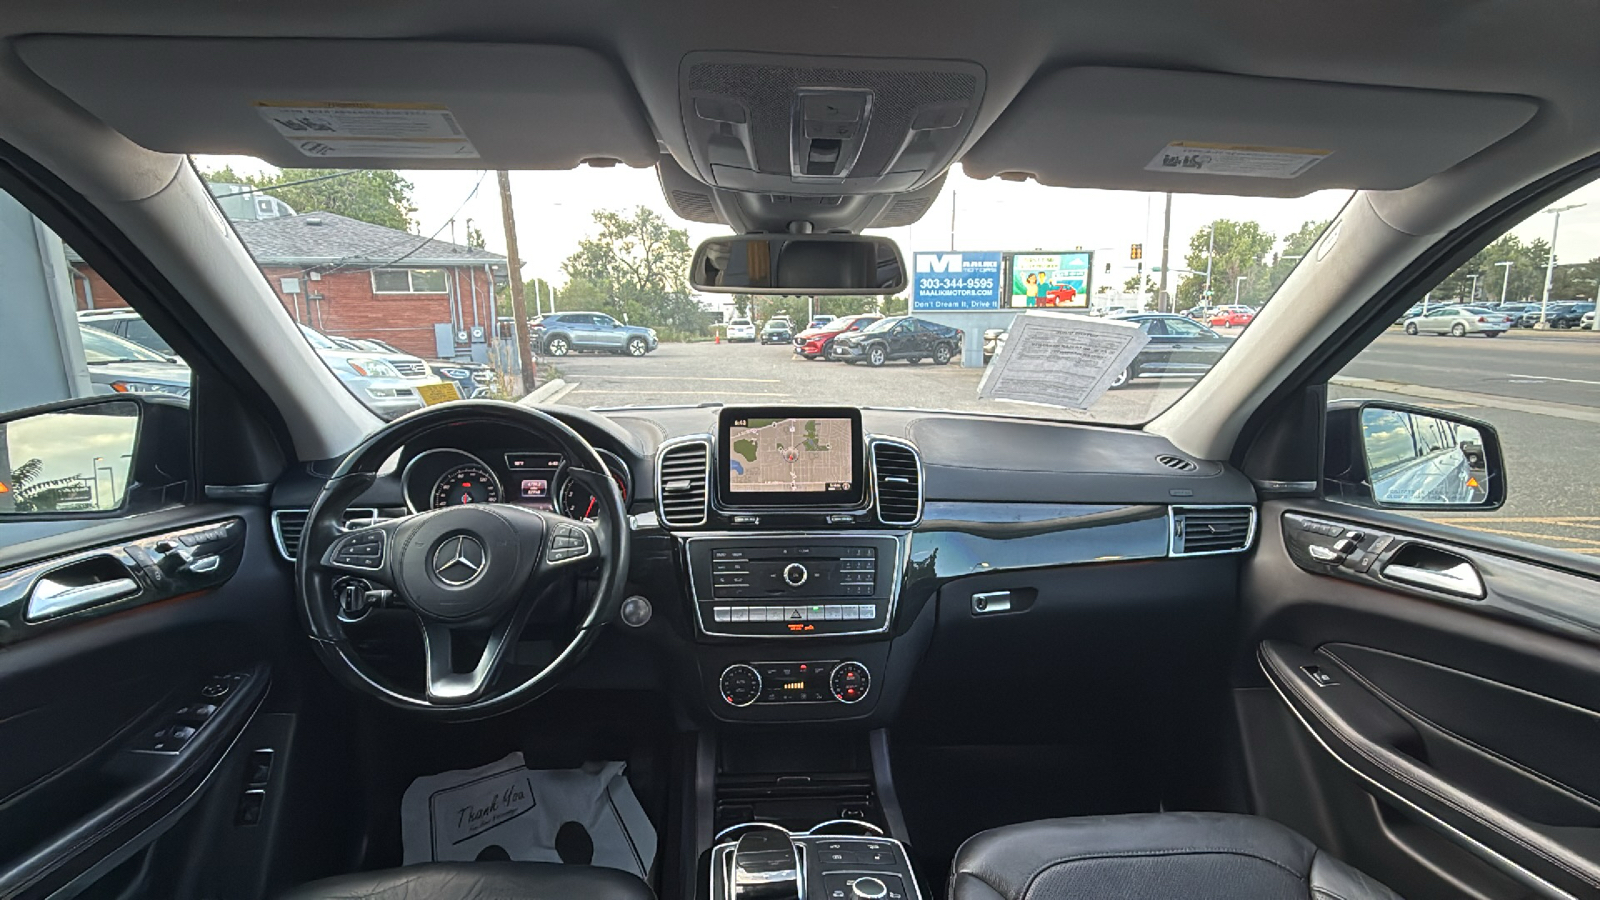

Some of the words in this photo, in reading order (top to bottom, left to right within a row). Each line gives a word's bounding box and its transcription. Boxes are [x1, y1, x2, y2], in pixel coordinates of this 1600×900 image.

[919, 278, 994, 289] 303-344-9595
[914, 300, 934, 308] Don't
[935, 300, 960, 308] Dream
[971, 300, 990, 308] Drive
[458, 793, 498, 828] Thank
[503, 785, 525, 807] You
